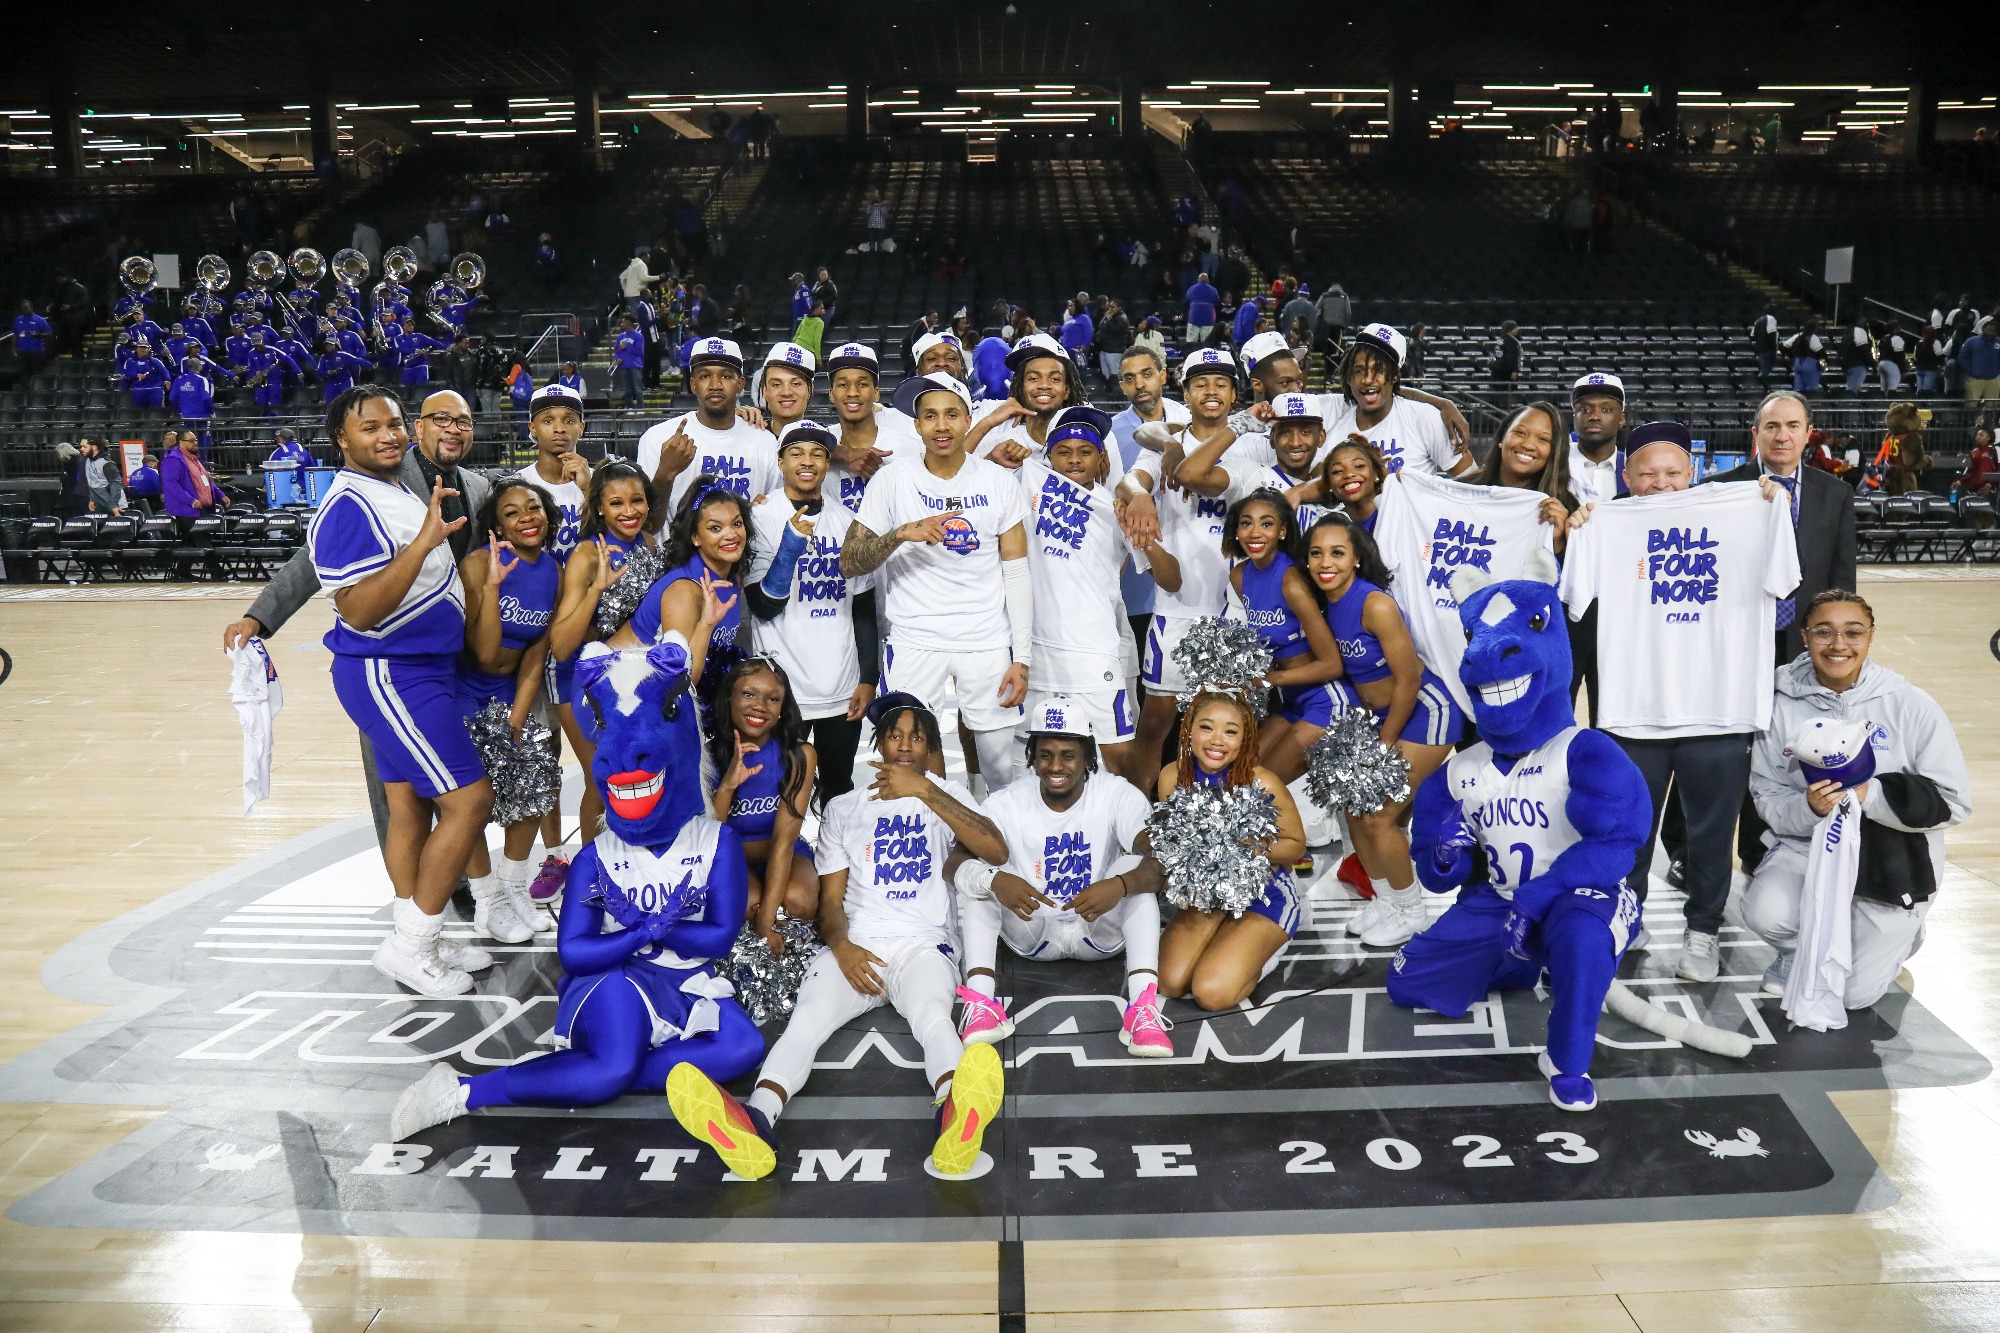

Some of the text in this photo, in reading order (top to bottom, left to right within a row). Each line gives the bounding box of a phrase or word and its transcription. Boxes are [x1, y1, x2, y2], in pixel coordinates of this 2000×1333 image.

[701, 455, 751, 476] BALL
[1042, 473, 1094, 511] BALL
[1039, 494, 1090, 536] FOUR
[1196, 498, 1228, 518] MO
[1036, 515, 1085, 551] MORE
[1433, 517, 1497, 546] BALL
[1647, 527, 1719, 553] BALL
[1043, 545, 1071, 560] CIAA
[1430, 541, 1492, 575] FOUR
[1427, 565, 1457, 590] MO
[1637, 557, 1646, 580] FINAL
[1648, 553, 1719, 580] FOUR
[798, 580, 847, 602] MORE
[1651, 579, 1719, 605] MORE
[499, 595, 553, 626] Bronc
[810, 608, 838, 619] CIAA
[1435, 598, 1458, 611] CIA
[1666, 612, 1701, 624] CIAA
[874, 814, 927, 839] BALL
[1471, 797, 1550, 832] RONCOS
[873, 834, 932, 864] FOUR
[1044, 831, 1091, 857] BALL
[873, 858, 932, 886] MORE
[1044, 853, 1092, 881] FOUR
[886, 890, 918, 900] CIAA
[1044, 873, 1092, 896] MORE
[351, 1131, 1600, 1183] BALTMORE 2023
